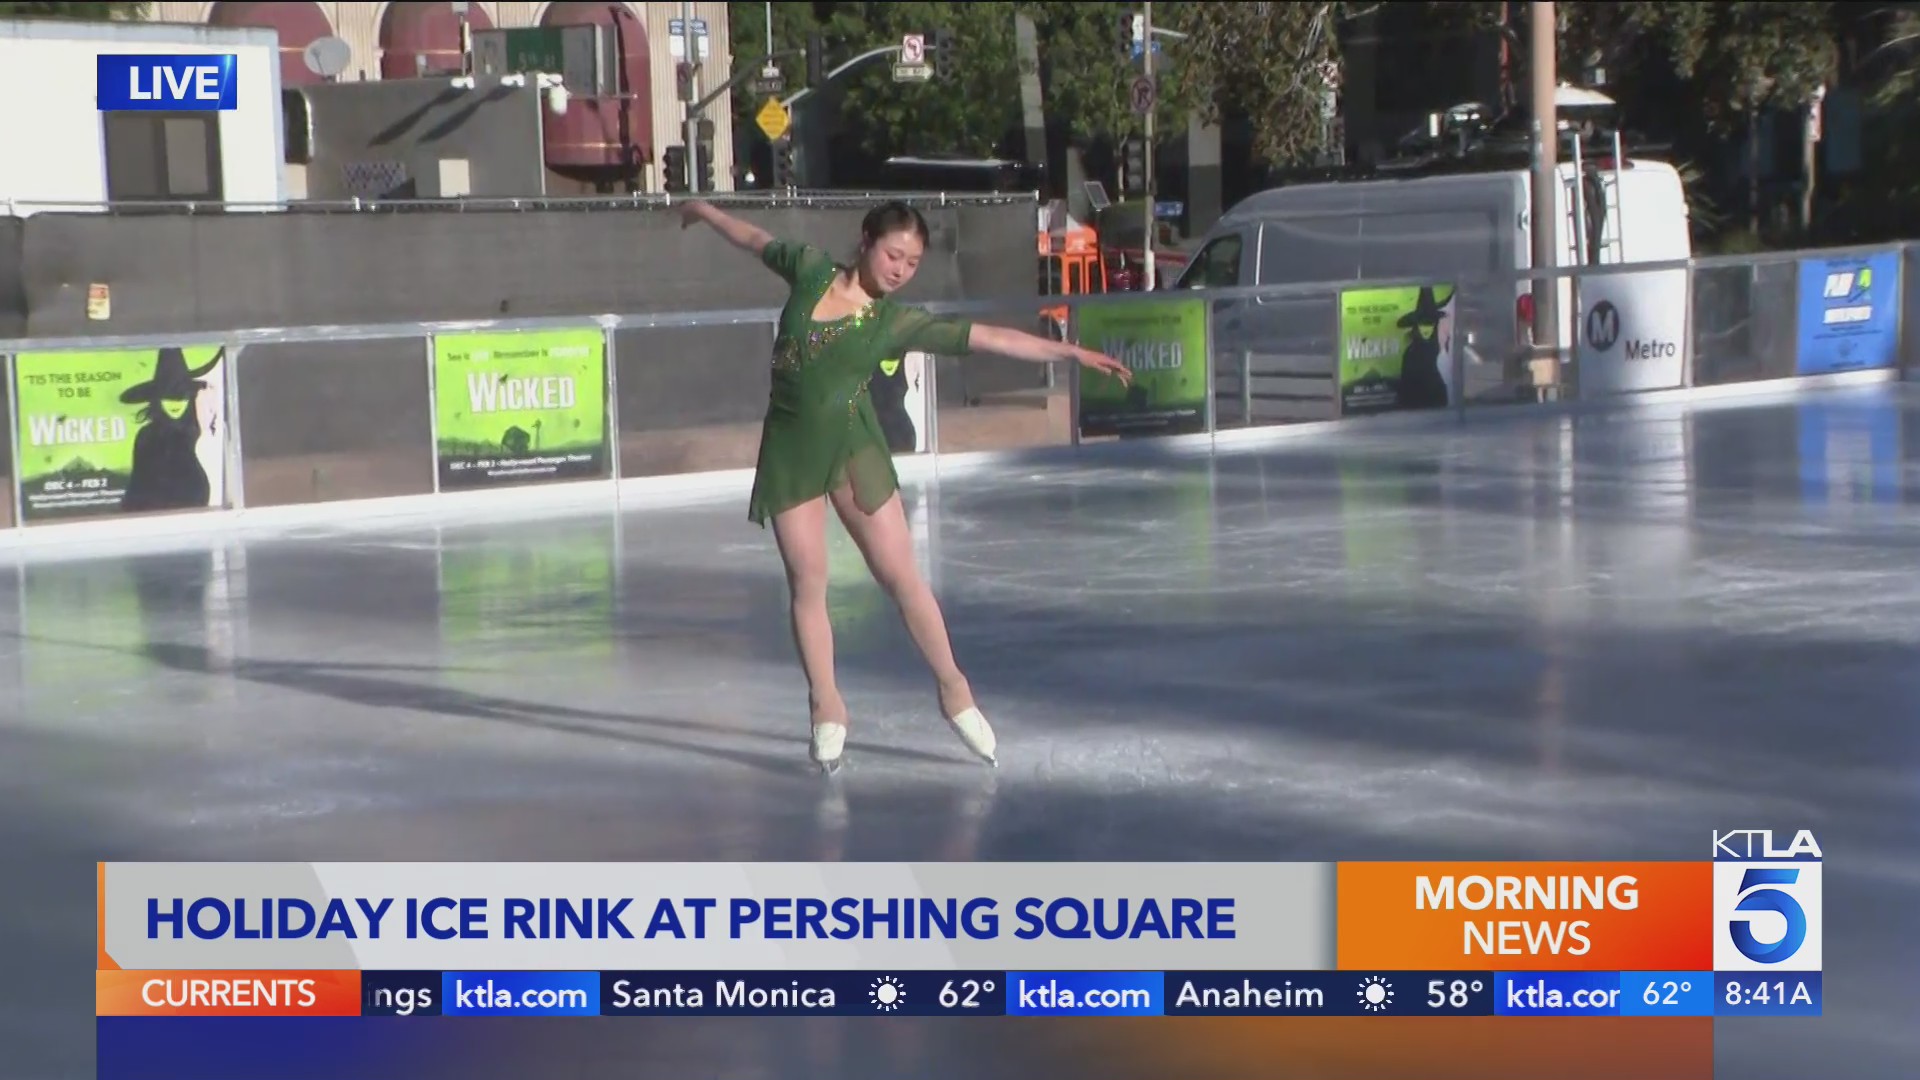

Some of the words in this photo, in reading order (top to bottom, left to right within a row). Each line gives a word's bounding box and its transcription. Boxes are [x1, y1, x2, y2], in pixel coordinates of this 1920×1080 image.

[1625, 339, 1675, 361] Metro
[51, 373, 71, 384] THE
[75, 371, 121, 383] SEASON
[58, 388, 75, 398] TO
[78, 387, 91, 397] BE
